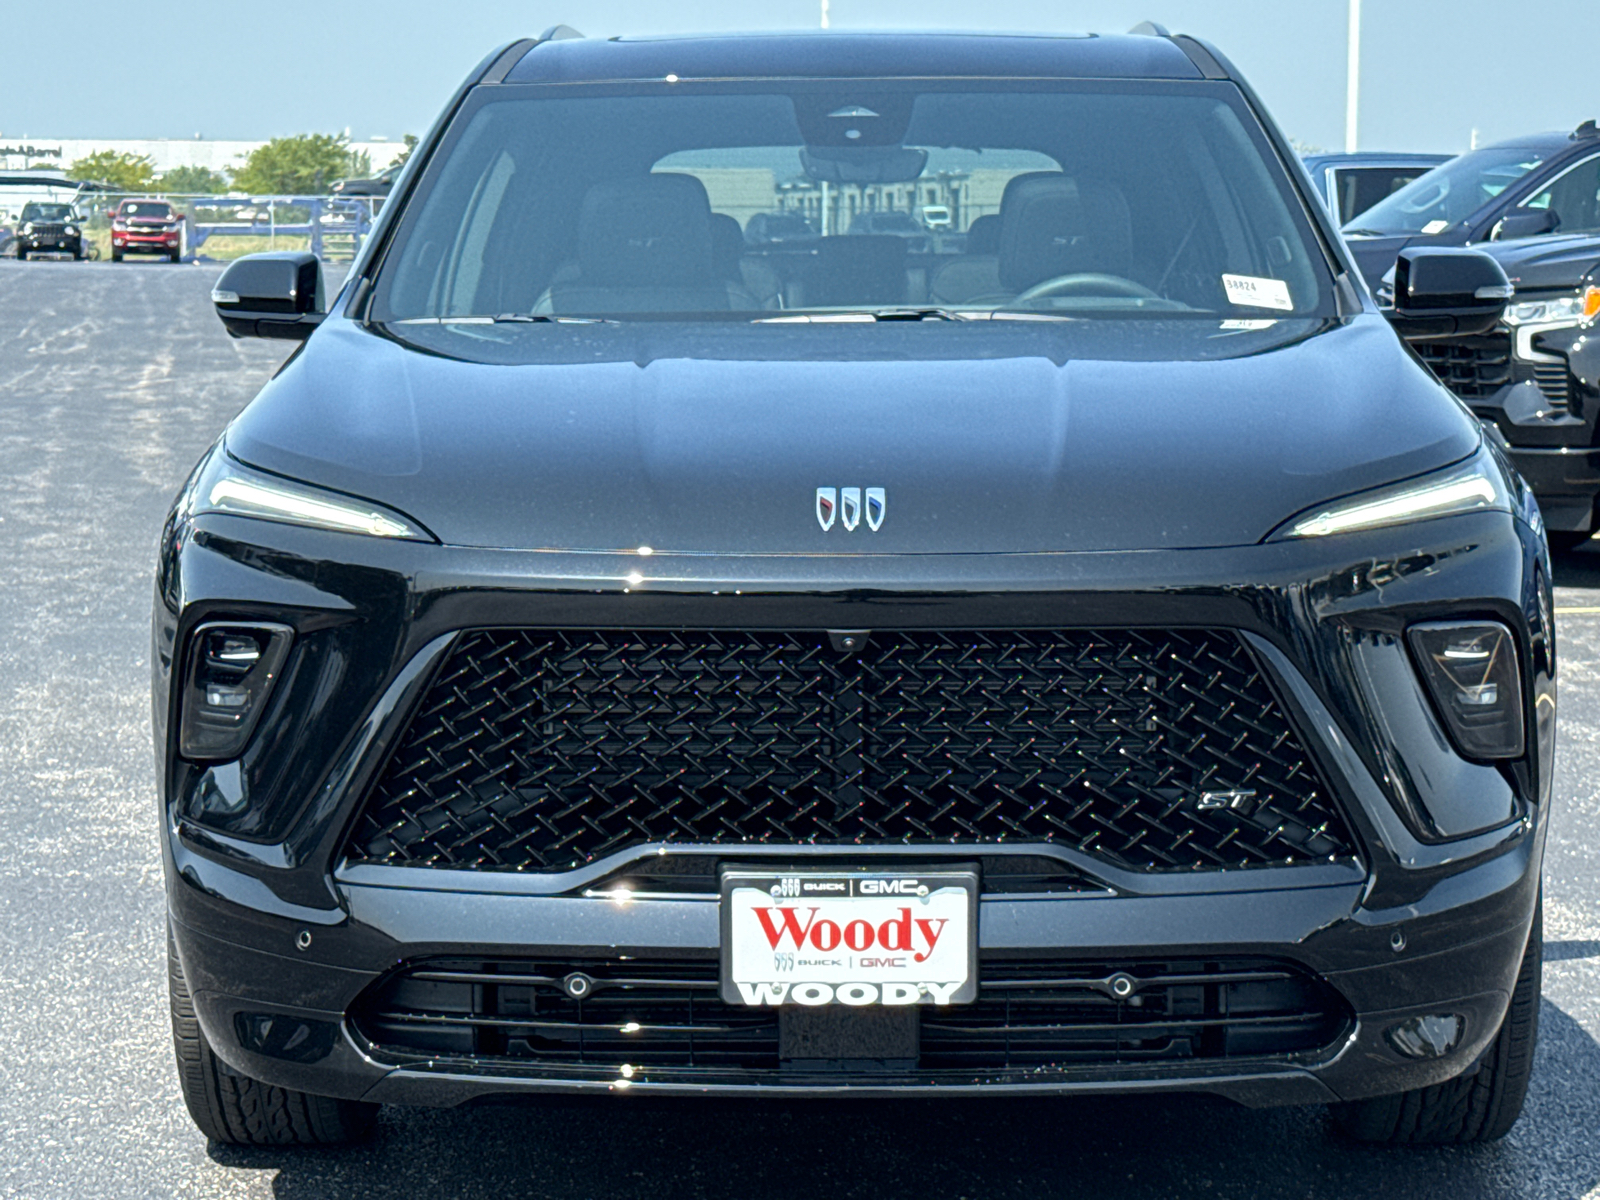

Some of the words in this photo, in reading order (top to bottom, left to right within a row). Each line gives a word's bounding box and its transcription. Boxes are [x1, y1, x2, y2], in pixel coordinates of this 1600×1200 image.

[803, 882, 846, 891] BUICK
[861, 879, 919, 894] GMC
[751, 907, 949, 963] Woody
[859, 957, 907, 968] GMC
[736, 982, 961, 1005] WOODY
